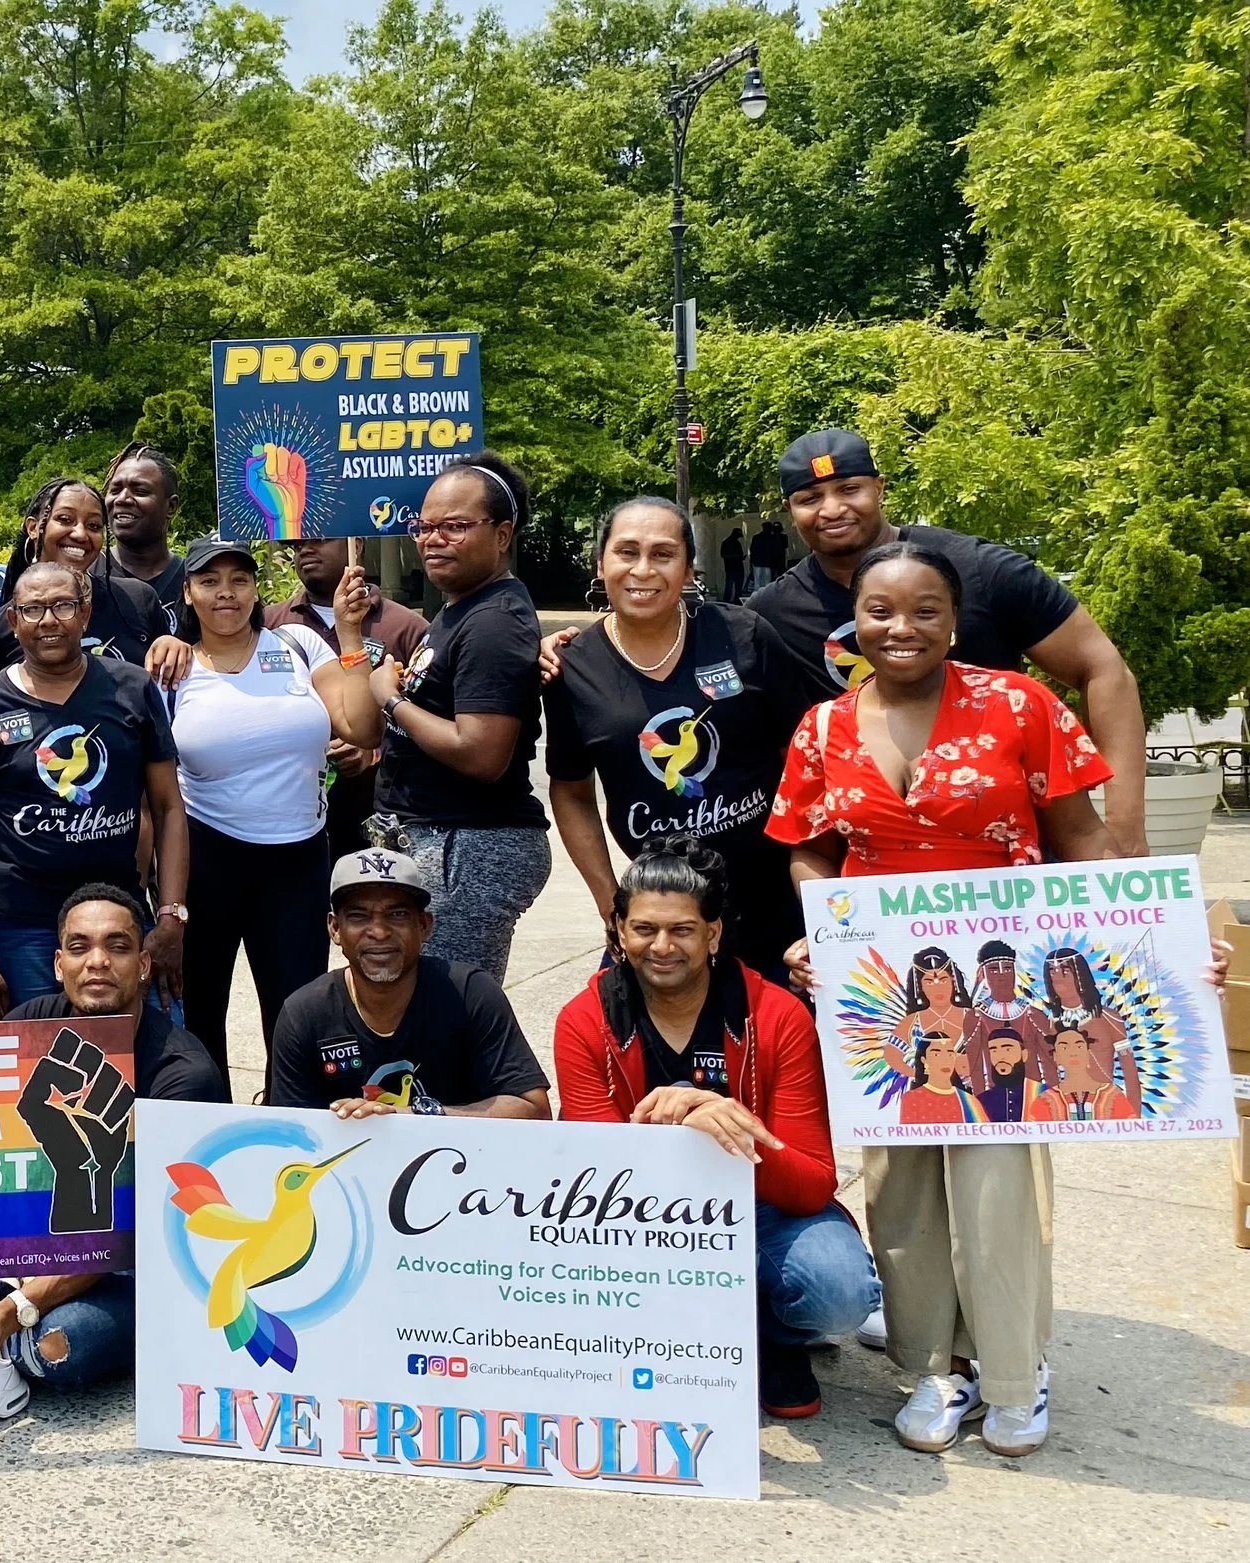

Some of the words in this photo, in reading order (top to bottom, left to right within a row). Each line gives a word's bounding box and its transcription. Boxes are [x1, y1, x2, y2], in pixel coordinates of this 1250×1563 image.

[223, 338, 470, 384] PROTECT
[338, 393, 387, 416] BLACK
[392, 393, 405, 414] &
[408, 391, 470, 413] BROWN
[338, 418, 473, 451] LGBTQ+
[342, 455, 404, 479] ASYLUM
[265, 655, 292, 663] VOTE
[364, 644, 384, 655] OTE
[704, 669, 738, 685] VOTE
[3, 716, 31, 730] VOTE
[13, 804, 136, 836] Caribbean
[50, 807, 67, 816] THE
[628, 788, 766, 839] Caribbean
[737, 800, 768, 825] PROJECT
[66, 829, 109, 843] EQUALITY
[357, 852, 397, 879] NY
[878, 877, 1036, 917] MASH-UP
[1043, 874, 1090, 907] DE
[1105, 868, 1193, 904] VOTE
[910, 918, 958, 938] OUR
[968, 914, 1030, 936] VOTE,
[1036, 911, 1090, 931] OUR
[1094, 907, 1166, 927] VOICE
[322, 1052, 326, 1061] I
[328, 1045, 361, 1060] VOTE
[699, 1057, 727, 1069] VOT
[853, 1125, 885, 1138] NYC
[888, 1124, 951, 1138] PRIMARY
[957, 1122, 1034, 1137] ELECTION:
[1037, 1120, 1110, 1136] TUESDAY,
[1115, 1119, 1155, 1134] JUNE
[1187, 1118, 1223, 1131] 2023
[387, 1147, 746, 1236] Caribbean
[530, 1226, 638, 1249] EQUALITY
[645, 1229, 738, 1252] PROJECT
[16, 1253, 52, 1266] LGBTQ+
[54, 1251, 81, 1263] Voices
[82, 1251, 90, 1261] in
[92, 1249, 111, 1261] NYC
[396, 1255, 514, 1282] Advocating
[519, 1261, 546, 1279] for
[551, 1264, 661, 1285] Caribbean
[667, 1268, 747, 1290] LGBTQ+
[499, 1284, 567, 1305] Voices
[572, 1287, 591, 1305] in
[597, 1288, 642, 1309] NYC
[397, 1325, 744, 1364] www.CaribbeanEqualityProject.org
[469, 1362, 613, 1383] @CaribbeanEqualityProject
[654, 1373, 738, 1390] @CaribEquality
[176, 1382, 322, 1458] LIVE
[337, 1397, 714, 1487] PRIDEFULLY
